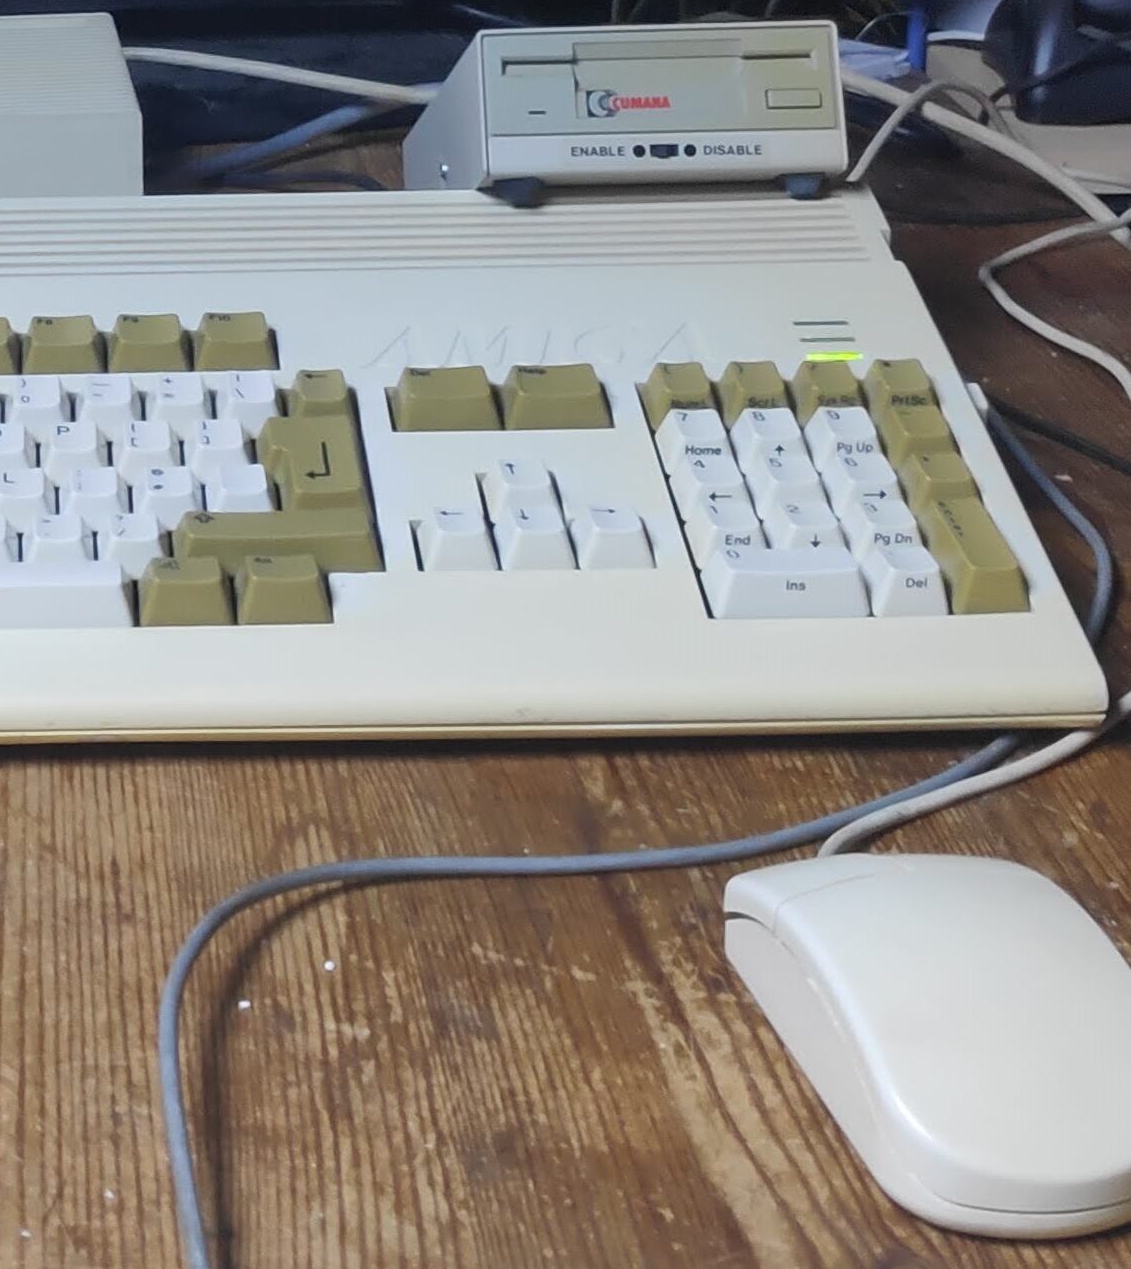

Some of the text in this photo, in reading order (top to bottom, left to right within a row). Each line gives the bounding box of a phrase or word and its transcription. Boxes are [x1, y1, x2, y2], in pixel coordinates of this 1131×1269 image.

[609, 95, 672, 112] CUMANA
[570, 146, 625, 157] ENABLE
[703, 144, 762, 156] DISABLE
[56, 425, 70, 436] P
[684, 445, 722, 456] Home
[836, 441, 874, 455] Pg Up
[3, 472, 14, 484] L
[724, 534, 751, 546] End
[873, 532, 913, 546] Pg Dn
[785, 580, 806, 591] Ins
[905, 577, 928, 589] Del
